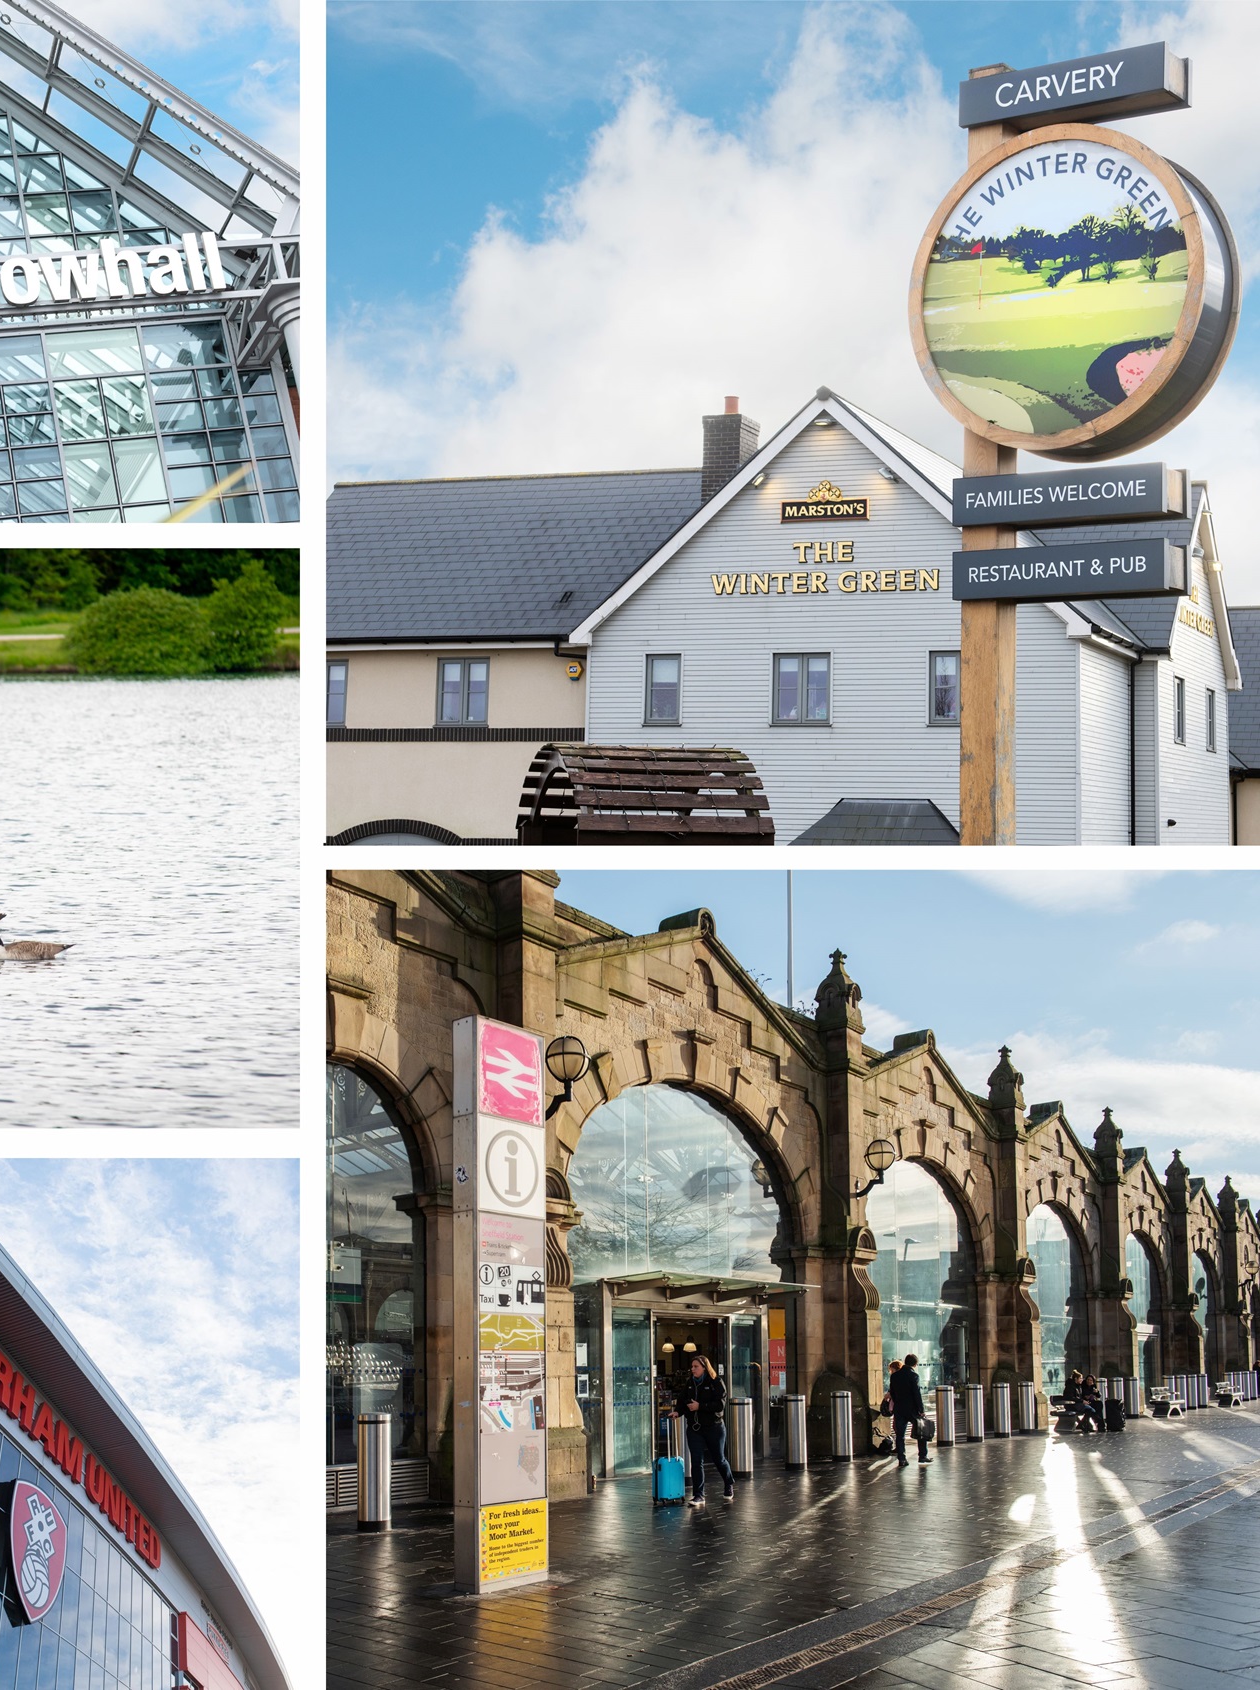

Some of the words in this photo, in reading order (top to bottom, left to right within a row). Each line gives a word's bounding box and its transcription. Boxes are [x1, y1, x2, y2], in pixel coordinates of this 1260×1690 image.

[995, 61, 1124, 108] CARVERY
[980, 152, 1088, 207] WINTER
[1096, 157, 1173, 232] GREEN
[965, 488, 1043, 509] FAMILIES
[1049, 479, 1147, 502] WELCOME
[784, 502, 865, 517] MARSTON'S
[792, 541, 854, 563] THE
[968, 559, 1085, 583] RESTAURANT
[1090, 558, 1103, 575] &
[1110, 555, 1147, 574] PUB
[710, 571, 828, 595] WINTER
[837, 568, 940, 593] GREEN
[506, 1232, 524, 1241] Station
[480, 1294, 494, 1304] Taxi
[84, 1452, 162, 1569] UNITED
[489, 1512, 501, 1520] For
[503, 1510, 520, 1518] fresh
[489, 1532, 507, 1541] Moor
[509, 1528, 535, 1538] Market.
[504, 1521, 520, 1530] your
